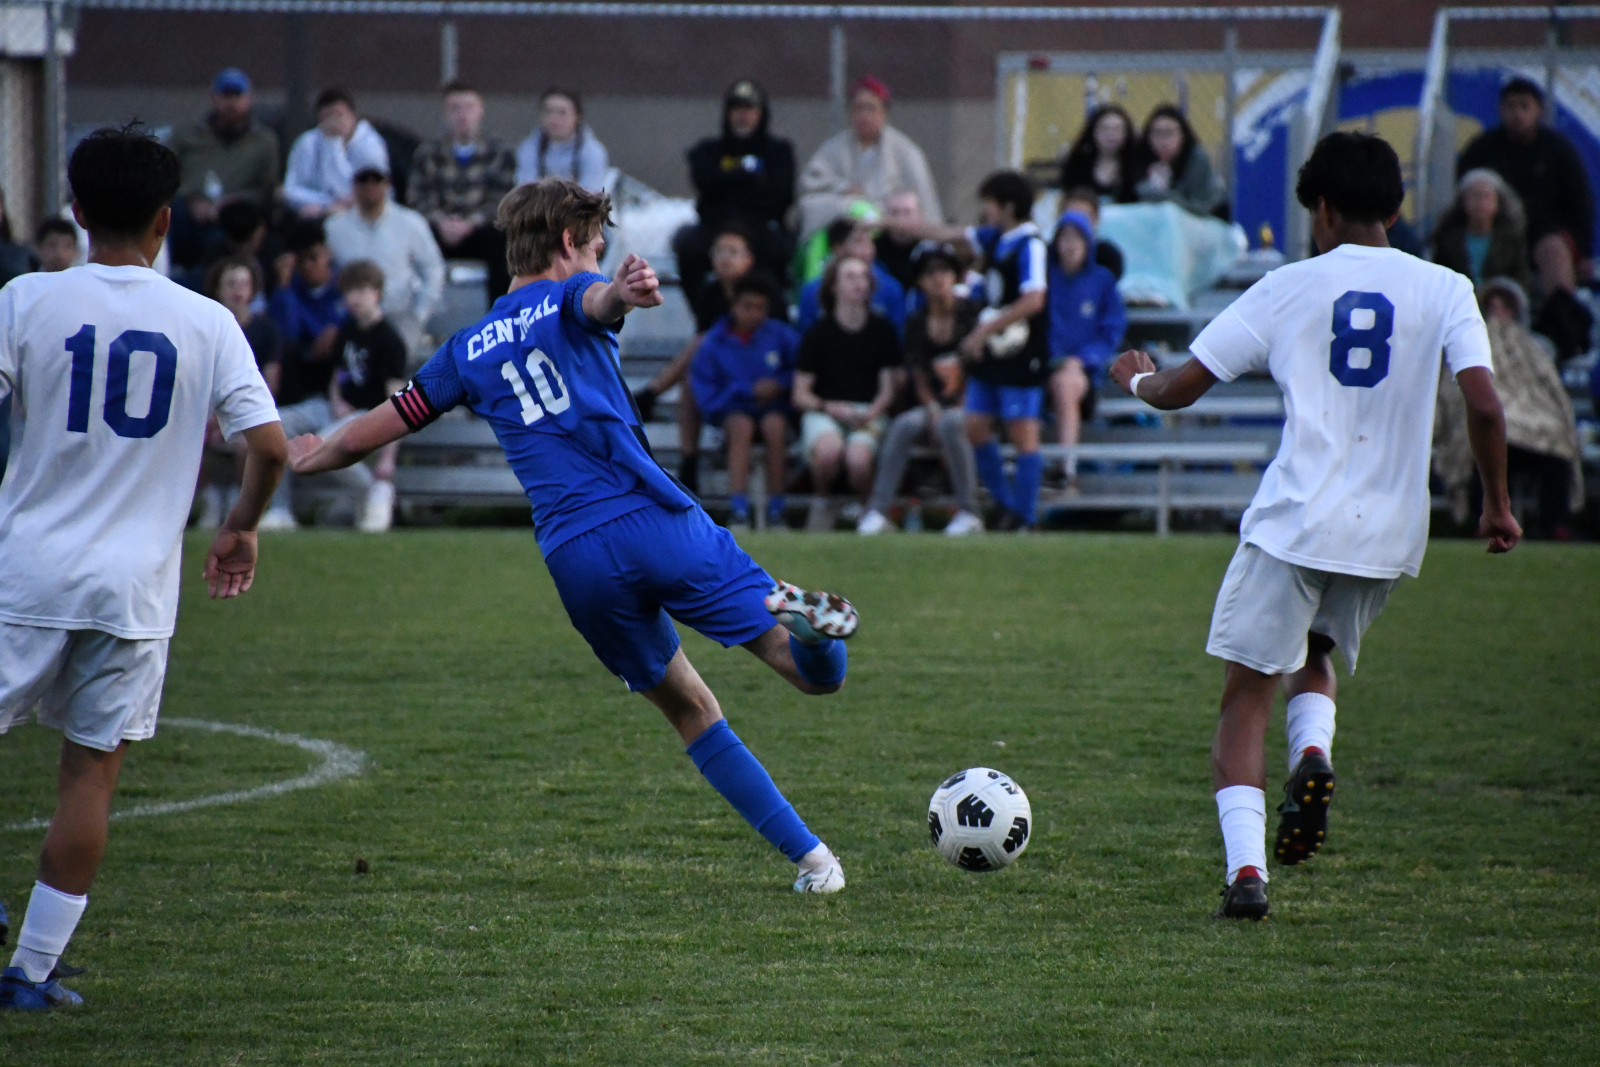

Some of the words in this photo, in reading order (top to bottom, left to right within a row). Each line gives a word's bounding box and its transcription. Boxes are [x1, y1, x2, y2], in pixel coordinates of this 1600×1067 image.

[467, 294, 559, 361] CENTRAL
[1329, 290, 1395, 389] 8
[65, 323, 178, 439] 10
[501, 347, 571, 426] 10
